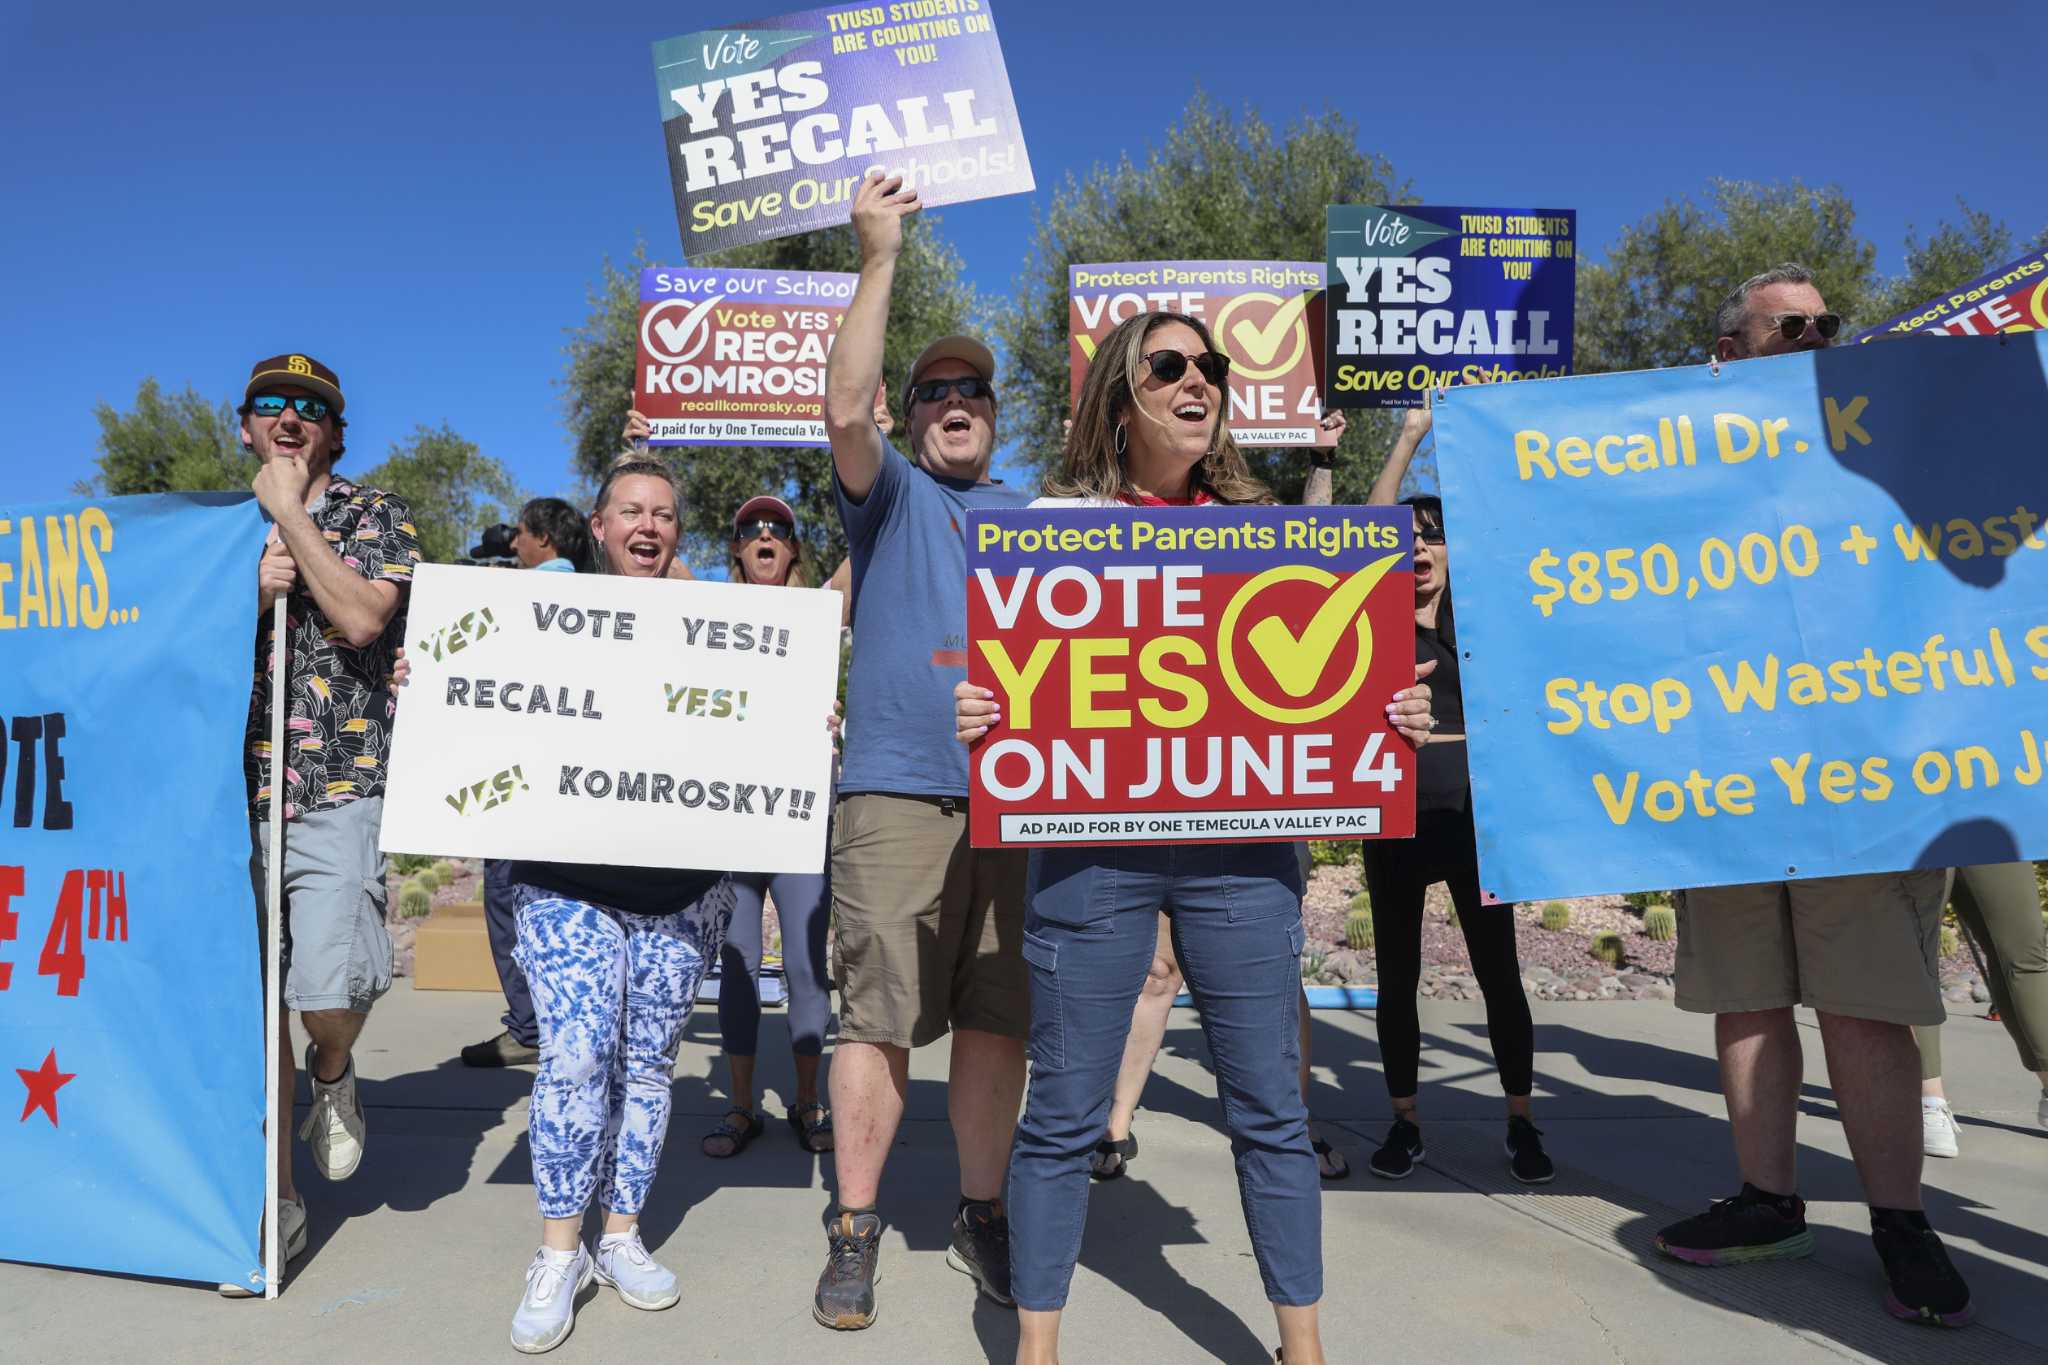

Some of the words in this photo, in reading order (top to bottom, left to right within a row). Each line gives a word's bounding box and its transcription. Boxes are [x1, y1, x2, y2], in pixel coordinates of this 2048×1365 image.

[827, 7, 886, 33] TVUSD
[889, 0, 980, 22] STUDENTS
[832, 32, 868, 55] ARE
[871, 18, 961, 48] COUNTING
[964, 14, 991, 33] ON
[702, 33, 761, 71] Vote
[894, 44, 938, 67] YOU!
[670, 60, 829, 134] YES
[679, 88, 999, 193] RECALL
[690, 191, 784, 233] Save
[789, 175, 860, 211] Our
[1365, 212, 1411, 247] Vote
[1460, 215, 1502, 234] TVUSD
[1505, 215, 1569, 236] STUDENTS
[1460, 238, 1486, 257] ARE
[1489, 238, 1552, 258] COUNTING
[1555, 240, 1573, 259] ON
[654, 274, 717, 294] Save
[725, 278, 767, 294] our
[775, 275, 858, 297] School
[1075, 269, 1158, 288] Protect
[1163, 268, 1247, 285] Parents
[1252, 268, 1320, 289] Rights
[1336, 256, 1452, 303] YES
[1502, 261, 1532, 280] YOU!
[1889, 303, 1950, 333] tect
[1948, 260, 2045, 309] Parents
[1923, 294, 2022, 336] TE
[715, 309, 776, 329] Vote
[783, 311, 829, 330] YES
[1336, 308, 1559, 356] RECALL
[714, 330, 836, 364] RECA
[645, 364, 827, 396] KOMROS
[1334, 364, 1408, 391] Save
[1408, 364, 1459, 391] Our
[681, 400, 822, 416] recallkomrosky.org
[1228, 385, 1287, 420] NE
[1296, 385, 1323, 420] 4
[662, 423, 686, 437] paid
[689, 423, 706, 435] for
[709, 423, 722, 437] by
[726, 424, 747, 435] One
[751, 424, 806, 436] Temecula
[1251, 432, 1287, 441] VALLEY
[1288, 431, 1308, 440] PAC
[1513, 413, 1697, 481] Recall
[1713, 411, 1809, 465] Dr.
[1825, 395, 1873, 452] K
[978, 522, 1123, 553] Protect
[1131, 520, 1276, 552] Parents
[1284, 517, 1400, 557] Rights
[1528, 523, 1820, 617] $850,000
[1893, 505, 2048, 561] wast
[975, 564, 1205, 630] VOTE
[418, 606, 501, 663] YES!
[532, 601, 637, 641] VOTE
[682, 616, 791, 657] YES!!
[446, 676, 603, 720] RECALL
[663, 682, 749, 722] YES!
[976, 635, 1209, 730] YES
[1544, 675, 1693, 736] Stop
[1707, 627, 2016, 715] Wasteful
[0, 712, 74, 830] TE
[979, 738, 1106, 802] ON
[1128, 733, 1335, 800] JUNE
[1352, 732, 1403, 793] 4
[1592, 770, 1756, 826] Vote
[1769, 752, 1893, 806] Yes
[1912, 745, 1999, 795] on
[445, 763, 531, 817] YES!
[558, 764, 817, 822] KOMROSKY!!
[1019, 823, 1043, 835] AD
[1047, 821, 1084, 835] PAID
[1088, 821, 1120, 834] FOR
[1124, 820, 1147, 833] BY
[1149, 819, 1183, 833] ONE
[1186, 817, 1271, 832] TEMECULA
[1274, 815, 1332, 830] VALLEY
[1337, 815, 1368, 828] PAC
